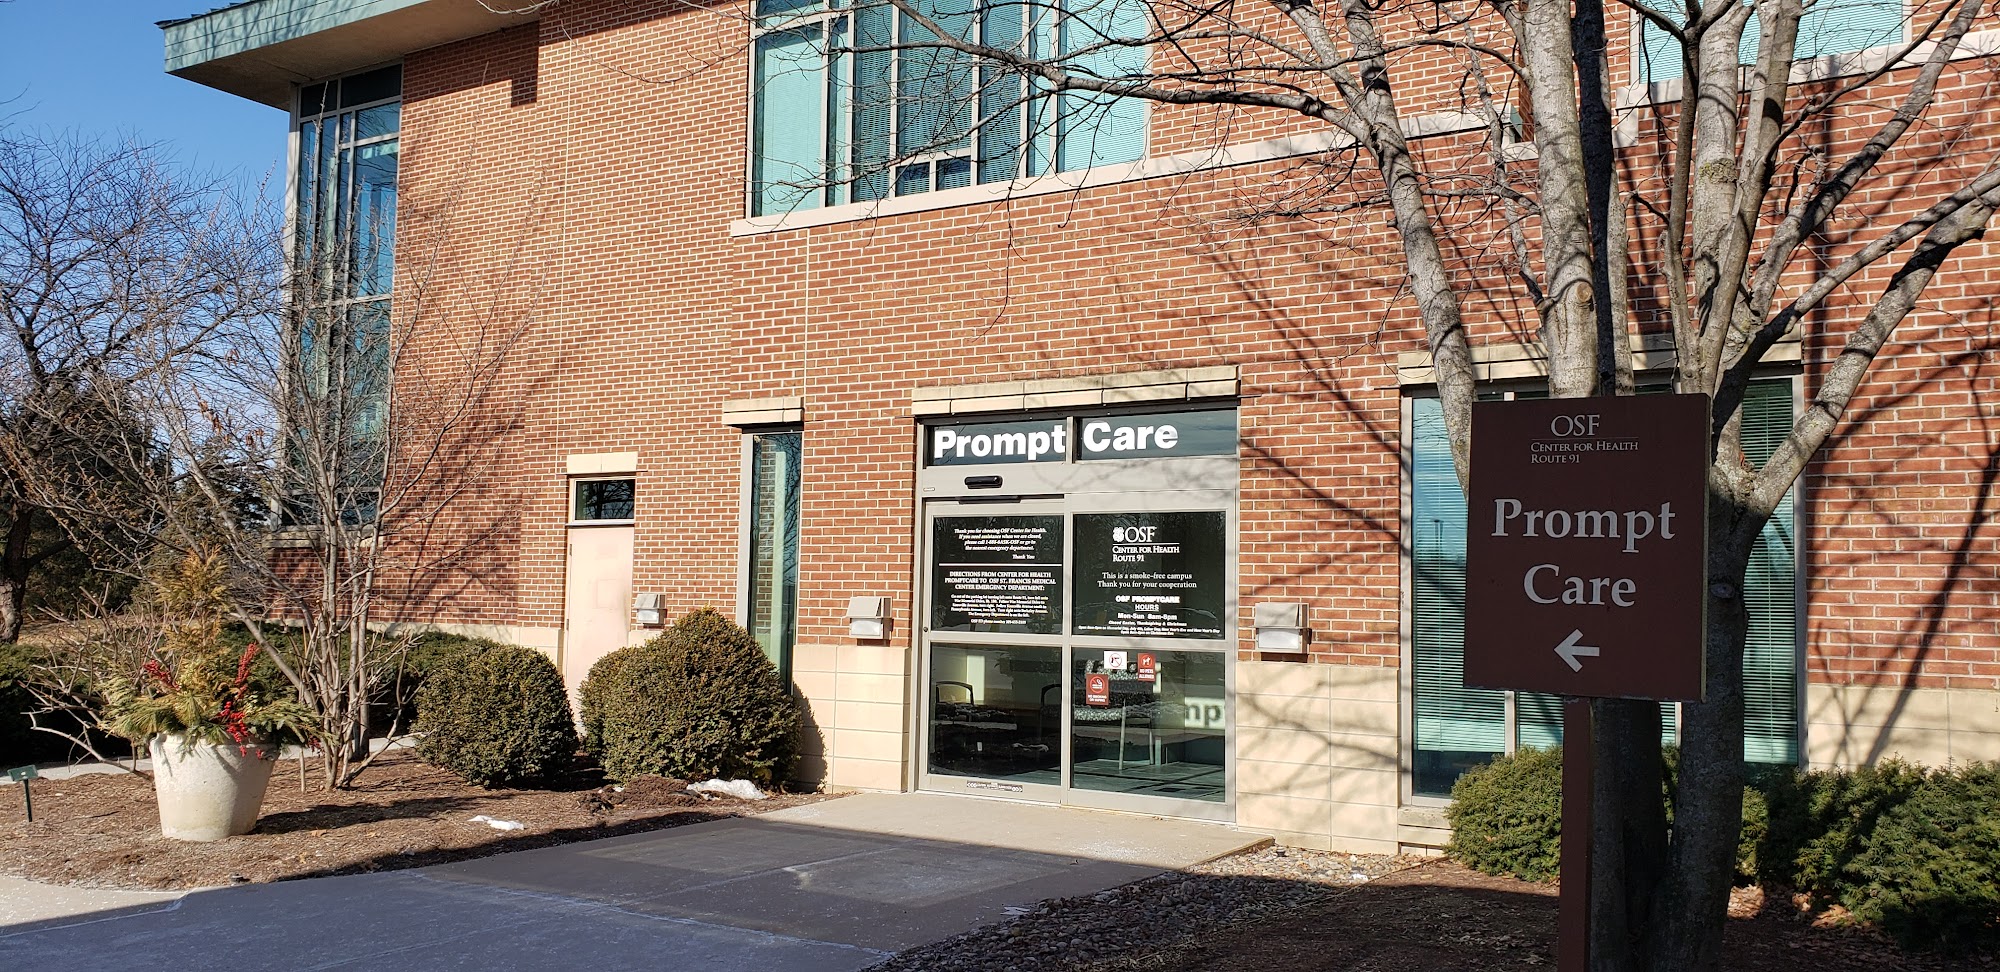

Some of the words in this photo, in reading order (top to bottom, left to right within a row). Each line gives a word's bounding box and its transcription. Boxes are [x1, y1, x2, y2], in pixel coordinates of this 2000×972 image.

[1550, 414, 1600, 437] OSF
[934, 424, 1066, 460] Prompt
[1083, 422, 1178, 452] Care
[1530, 442, 1571, 452] CENTER
[1574, 442, 1594, 452] FOR
[1596, 440, 1638, 451] HEALTH
[1531, 454, 1566, 464] ROUTE
[1568, 454, 1580, 463] 91
[1491, 498, 1676, 552] Prompt
[1125, 526, 1157, 542] OSF
[1158, 581, 1197, 589] cooperation
[1523, 564, 1636, 607] Care
[1131, 595, 1180, 604] PROMPTCARE
